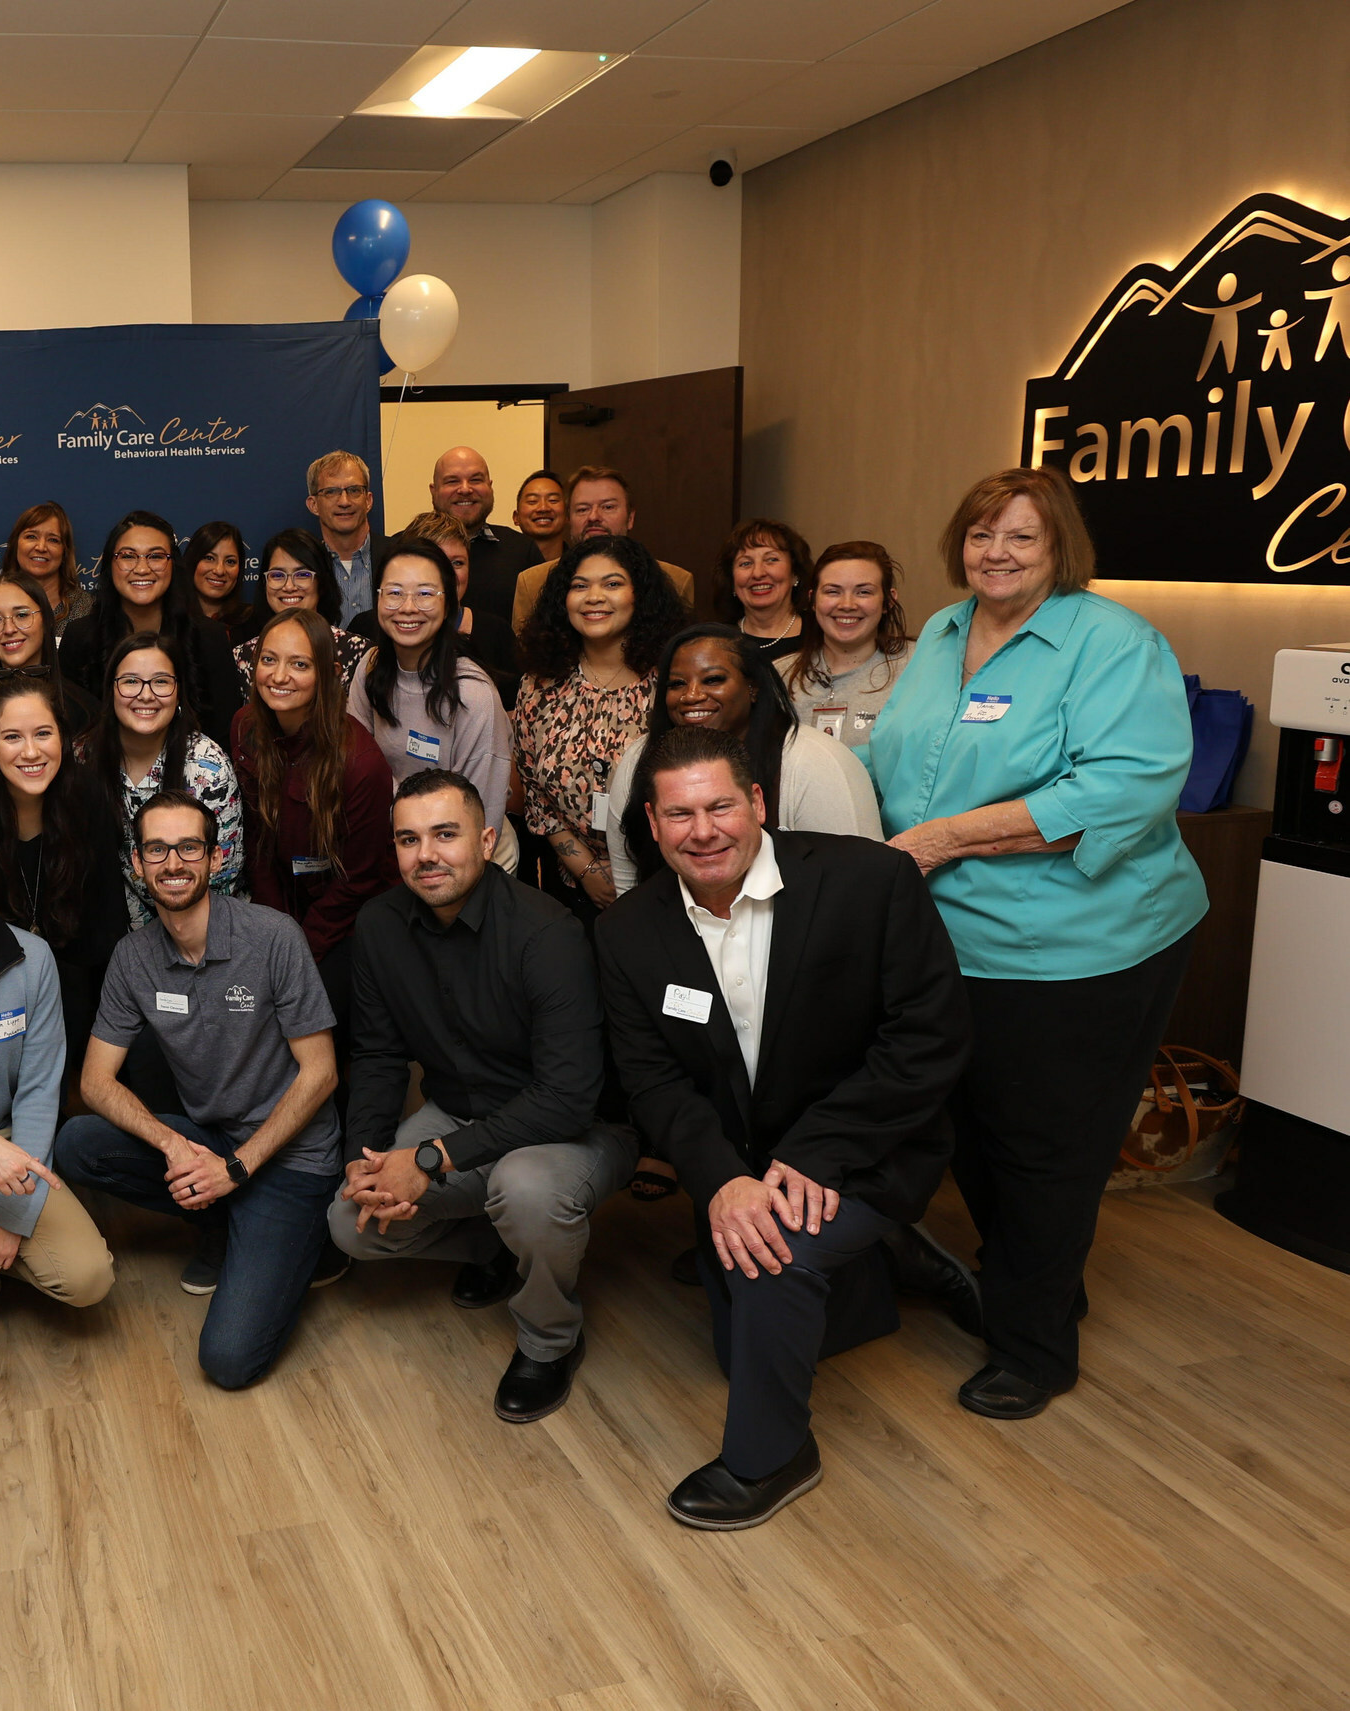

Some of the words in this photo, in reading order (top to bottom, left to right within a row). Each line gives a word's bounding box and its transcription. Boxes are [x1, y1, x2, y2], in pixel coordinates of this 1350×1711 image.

[58, 431, 113, 450] Family
[117, 430, 154, 446] Care
[159, 417, 249, 444] Center
[1031, 379, 1315, 500] Family
[114, 448, 168, 459] Behavioral
[170, 447, 203, 457] Health
[205, 446, 245, 456] Services
[244, 557, 259, 569] re
[225, 994, 242, 1003] Family
